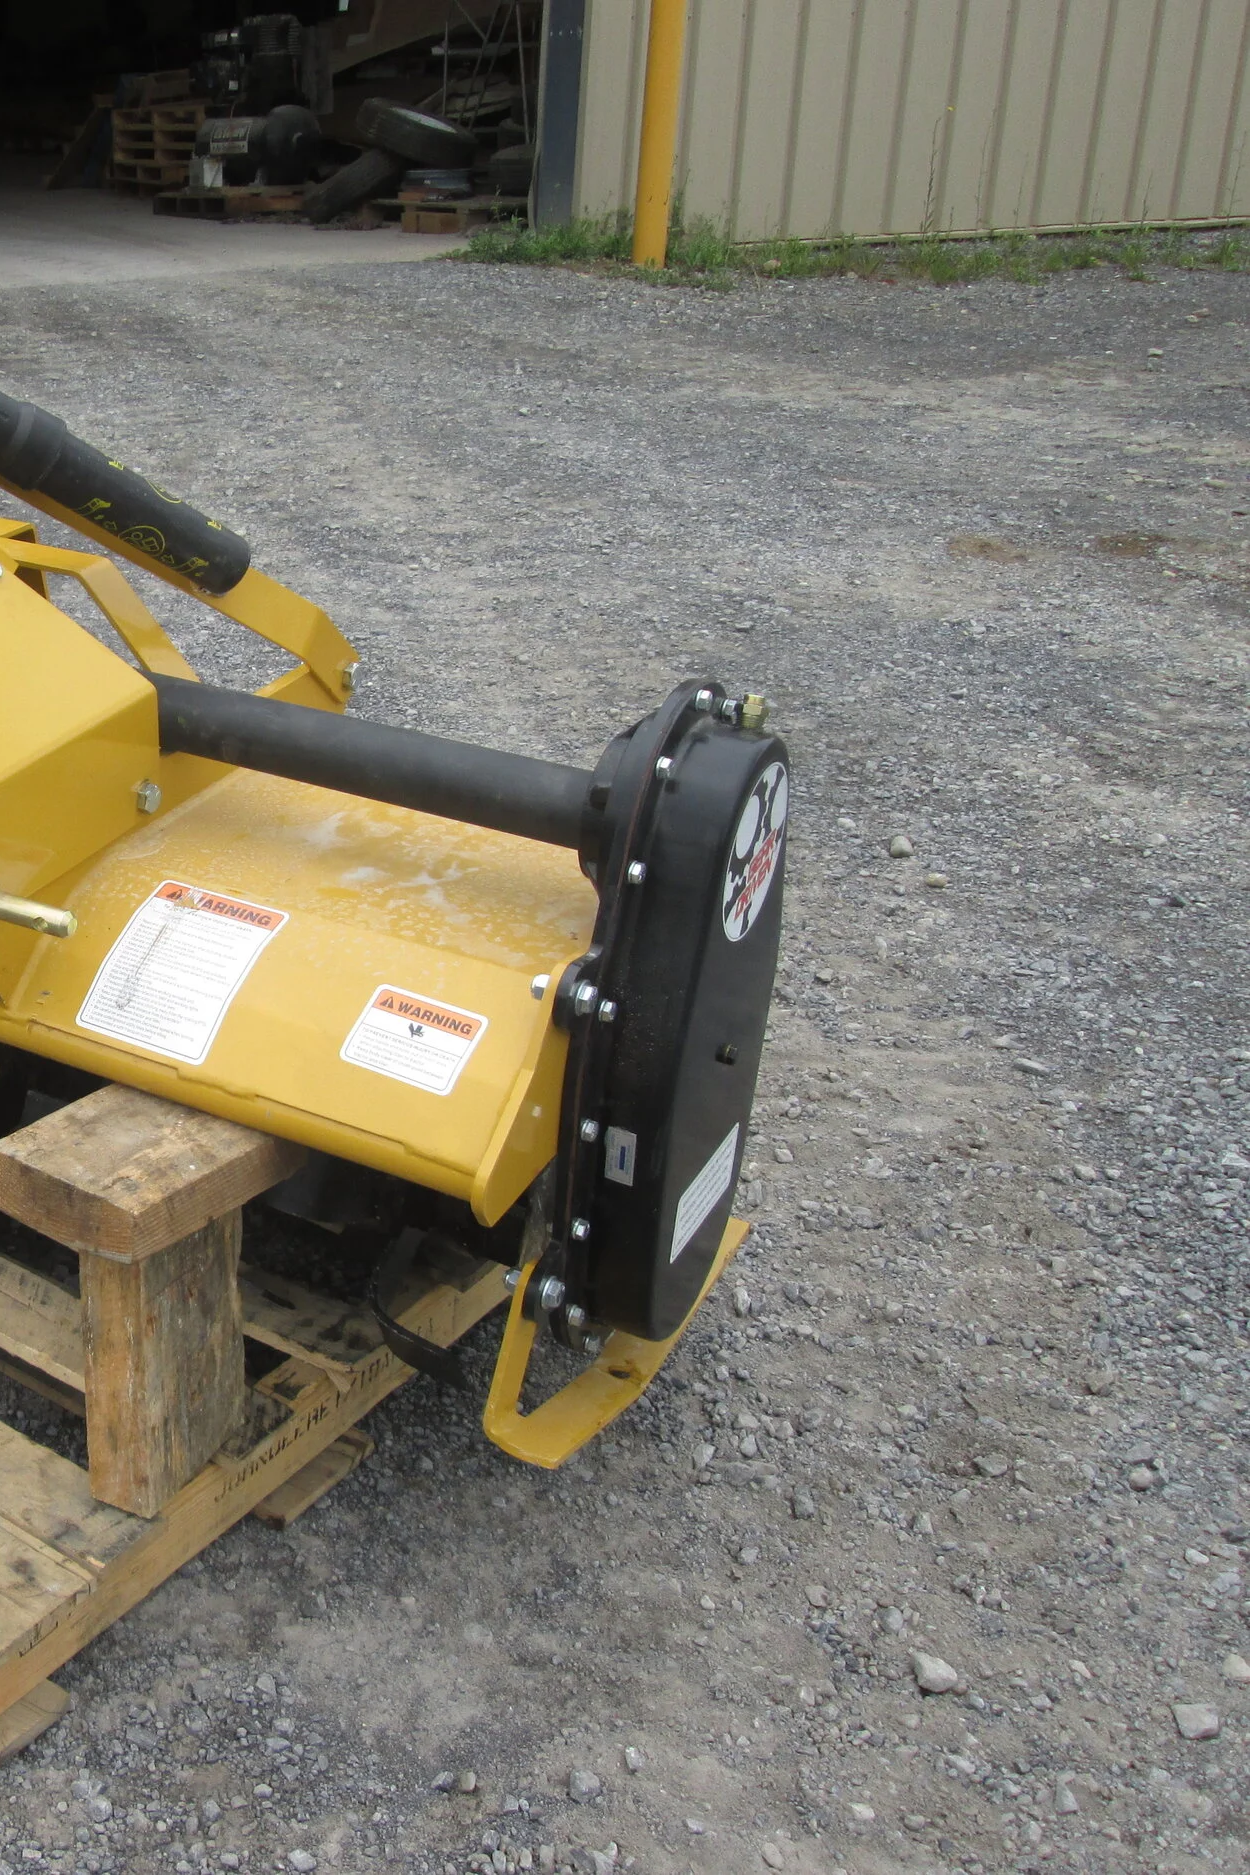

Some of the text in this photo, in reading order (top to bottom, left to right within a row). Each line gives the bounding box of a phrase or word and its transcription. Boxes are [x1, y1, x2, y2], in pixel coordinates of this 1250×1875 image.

[747, 829, 778, 884] GEAR
[734, 858, 773, 920] DRIVEN
[398, 1001, 473, 1035] WARNING
